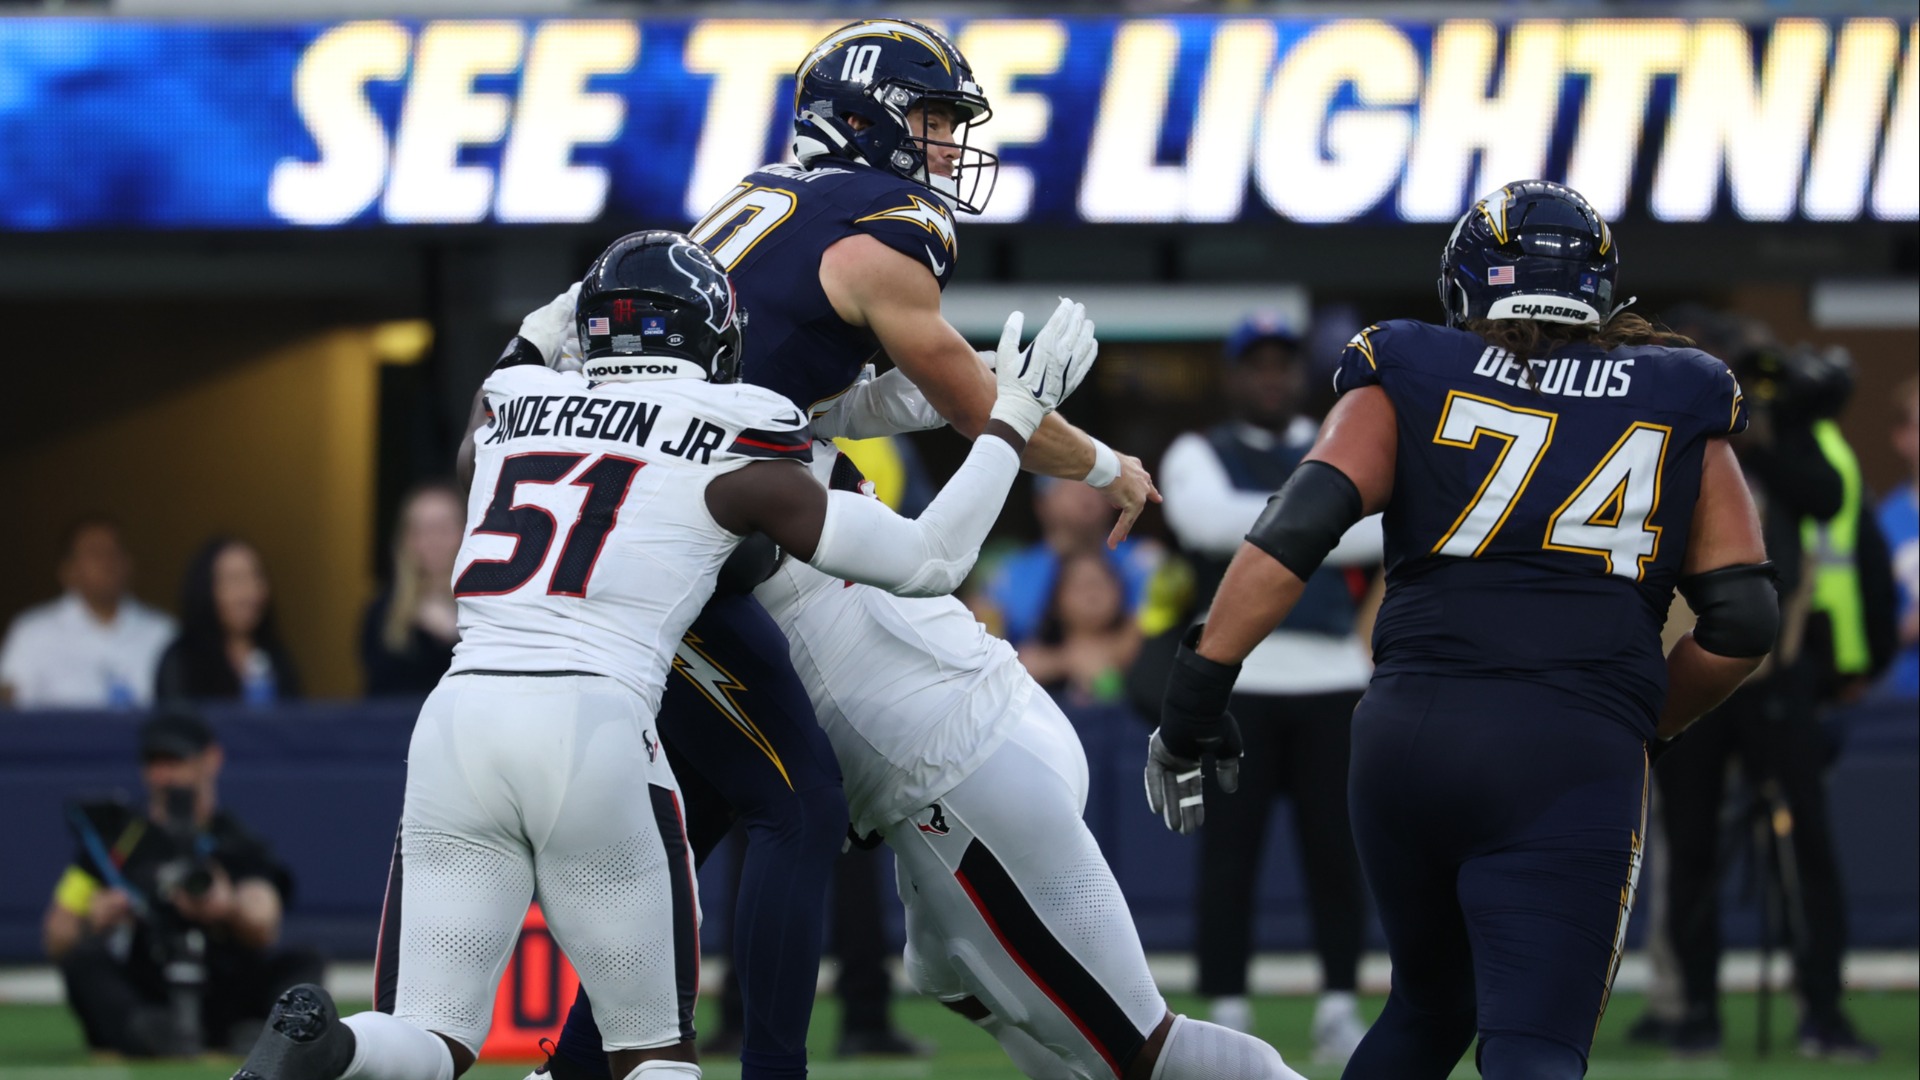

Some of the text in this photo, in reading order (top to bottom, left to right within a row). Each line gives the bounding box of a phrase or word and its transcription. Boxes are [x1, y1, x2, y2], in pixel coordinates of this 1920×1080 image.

[268, 19, 641, 224] SEE
[1511, 304, 1588, 320] CHARGERS
[587, 365, 677, 377] HOUSTON
[1473, 345, 1635, 398] DECULUS
[484, 396, 726, 465] ANDERSON JR
[1428, 389, 1672, 583] 74
[453, 451, 647, 598] 51
